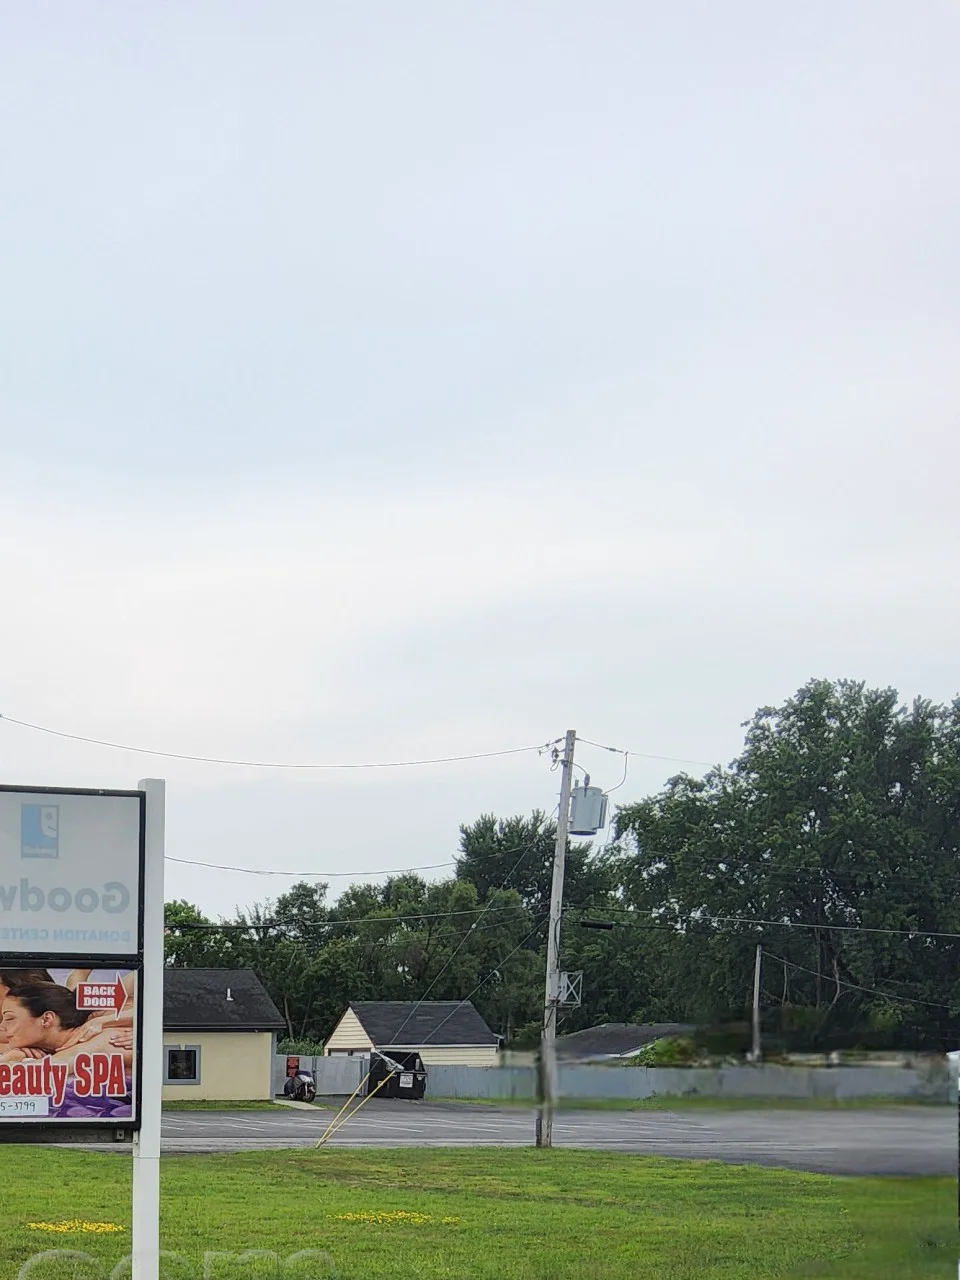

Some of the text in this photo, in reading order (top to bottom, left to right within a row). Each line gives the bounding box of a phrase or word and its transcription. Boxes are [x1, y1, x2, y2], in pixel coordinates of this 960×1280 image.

[83, 985, 116, 996] BACK
[83, 997, 115, 1008] DOOR
[75, 1053, 126, 1097] SPA
